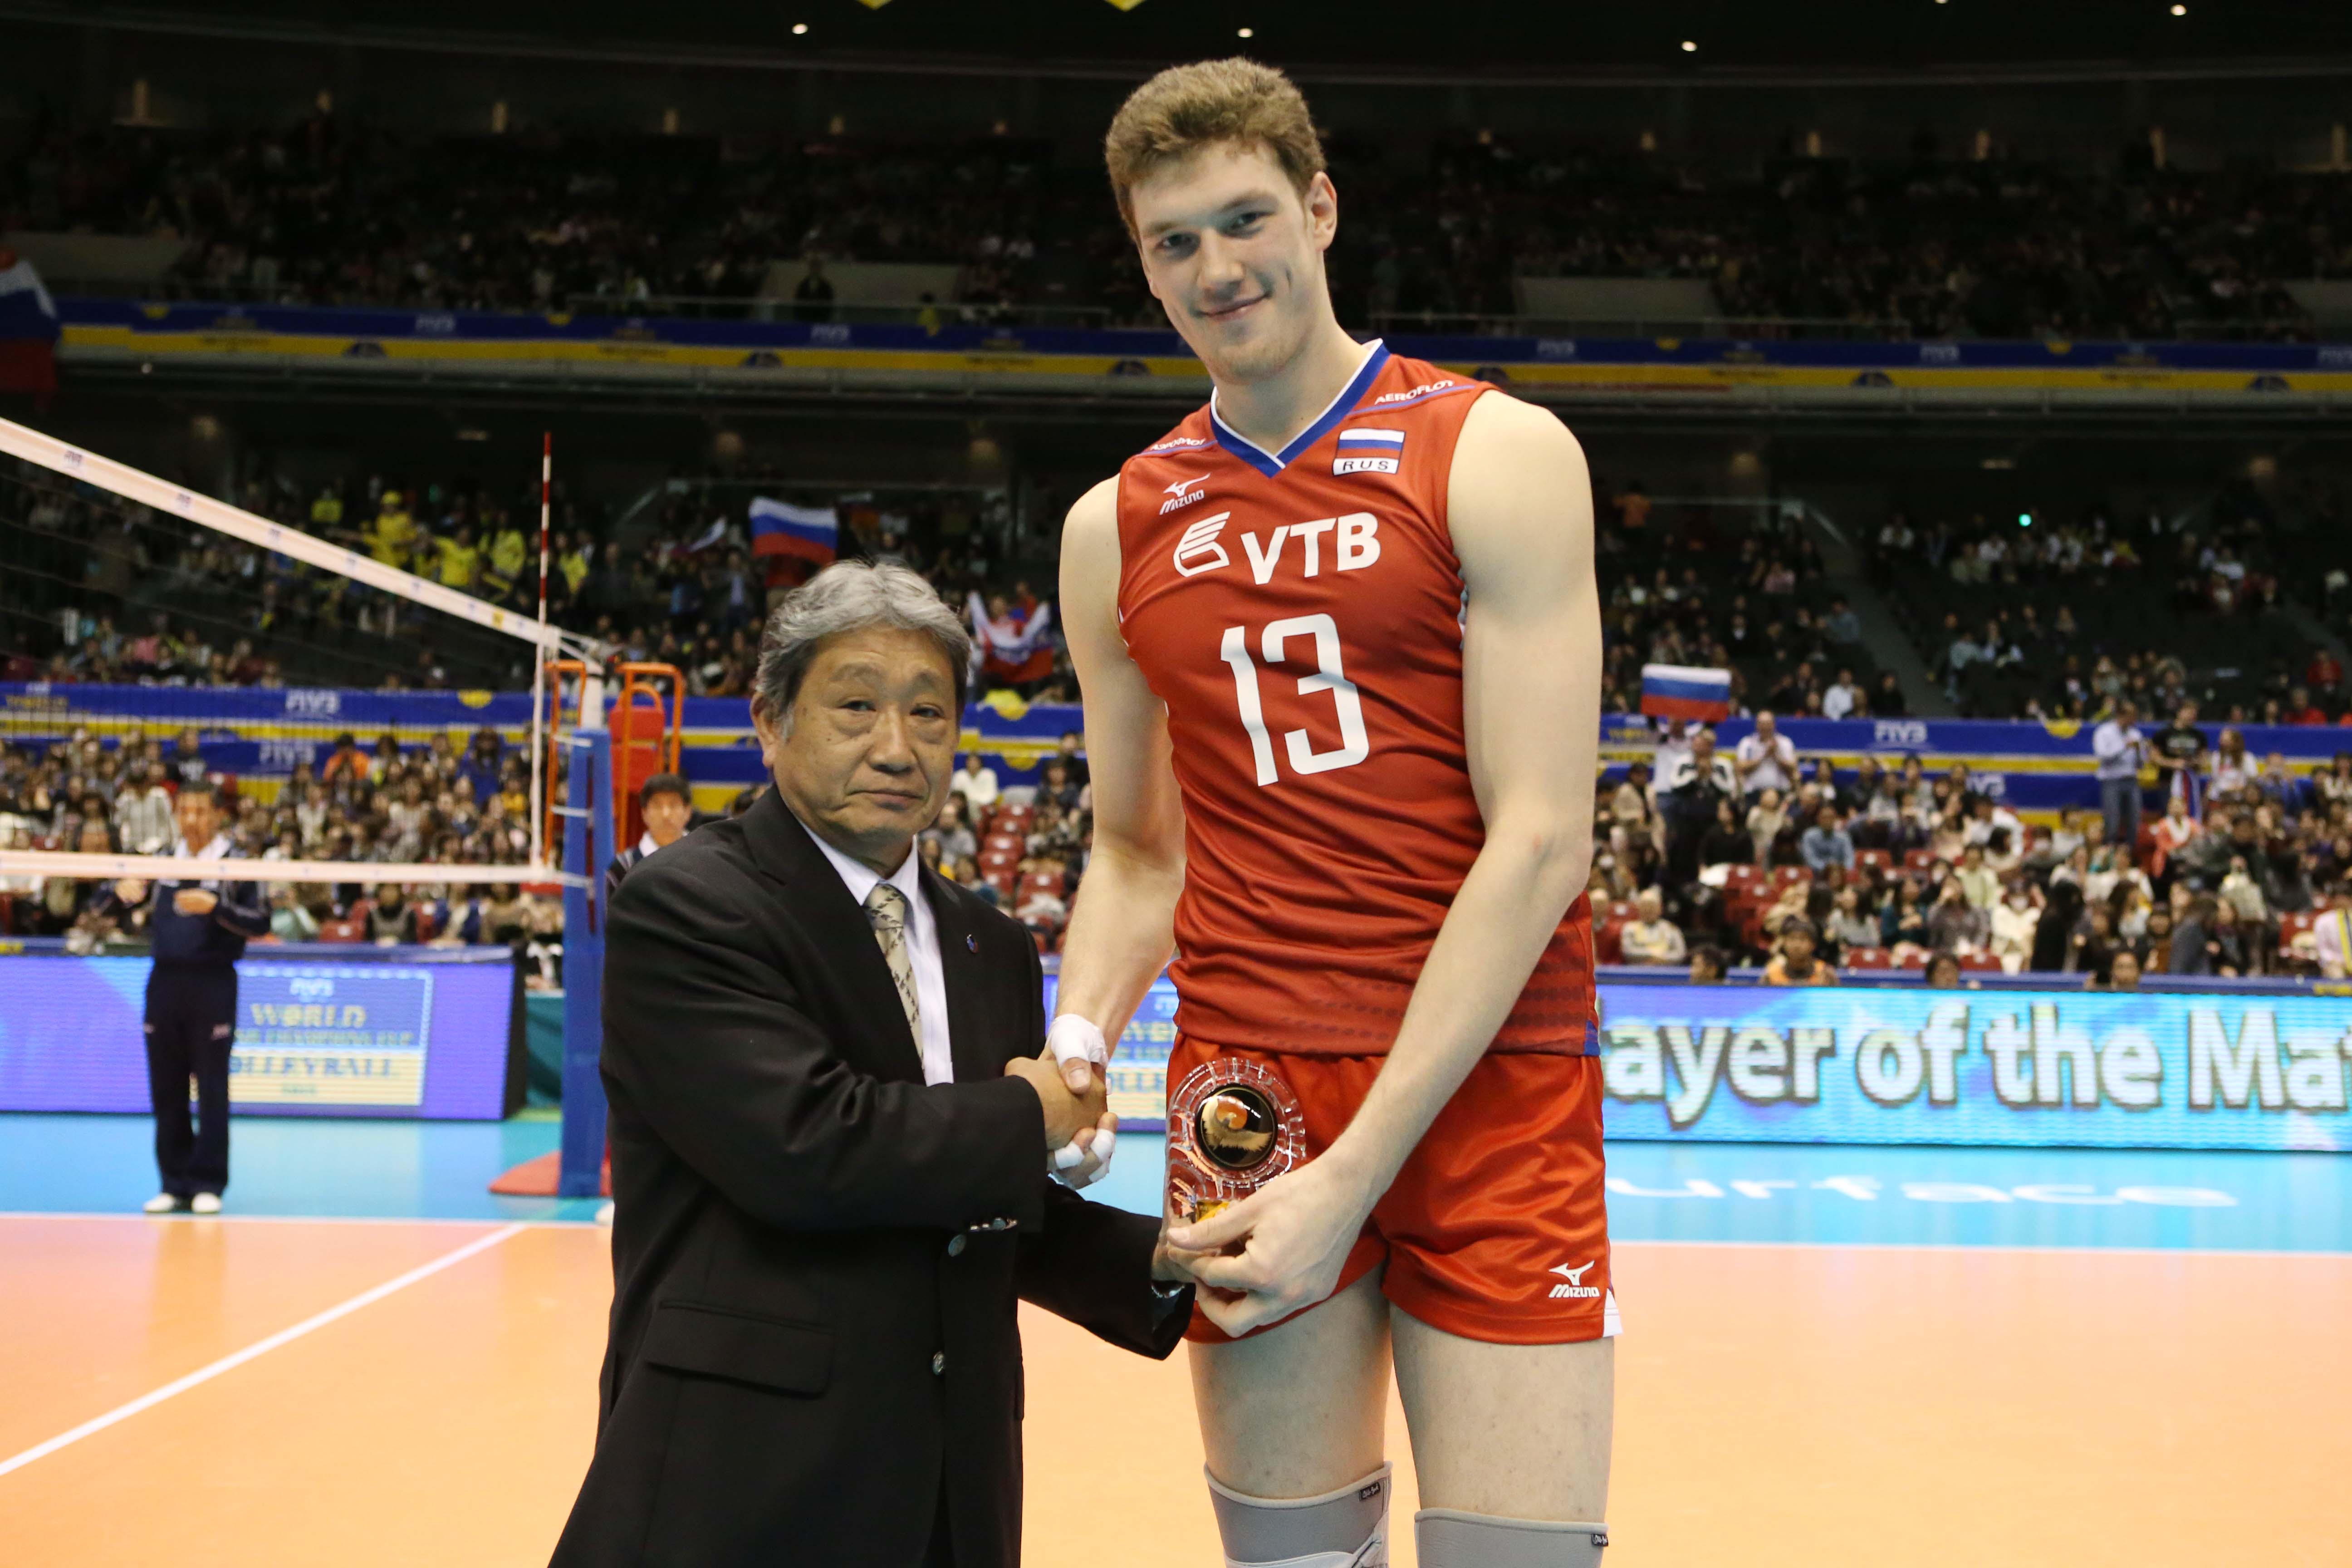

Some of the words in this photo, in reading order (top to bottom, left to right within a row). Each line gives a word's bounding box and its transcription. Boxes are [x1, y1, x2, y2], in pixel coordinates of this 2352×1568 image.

[1374, 379, 1455, 405] AEROFLOT
[1343, 460, 1389, 471] RUS
[1159, 489, 1205, 515] MIZUNO
[1240, 512, 1381, 585] VTB
[285, 689, 339, 714] FIVB
[1220, 613, 1369, 786] 13
[1874, 720, 1927, 743] FIVB
[1965, 771, 2006, 797] VB
[250, 1003, 367, 1028] WORLD
[229, 1056, 400, 1076] OLLEYBALL
[1602, 1021, 1836, 1128] ayer
[1855, 1000, 1970, 1108] of
[1983, 1000, 2163, 1110] the
[2187, 1006, 2352, 1114] Ma
[1605, 1176, 2239, 1207] urface
[1548, 1284, 1600, 1298] MIZUNO
